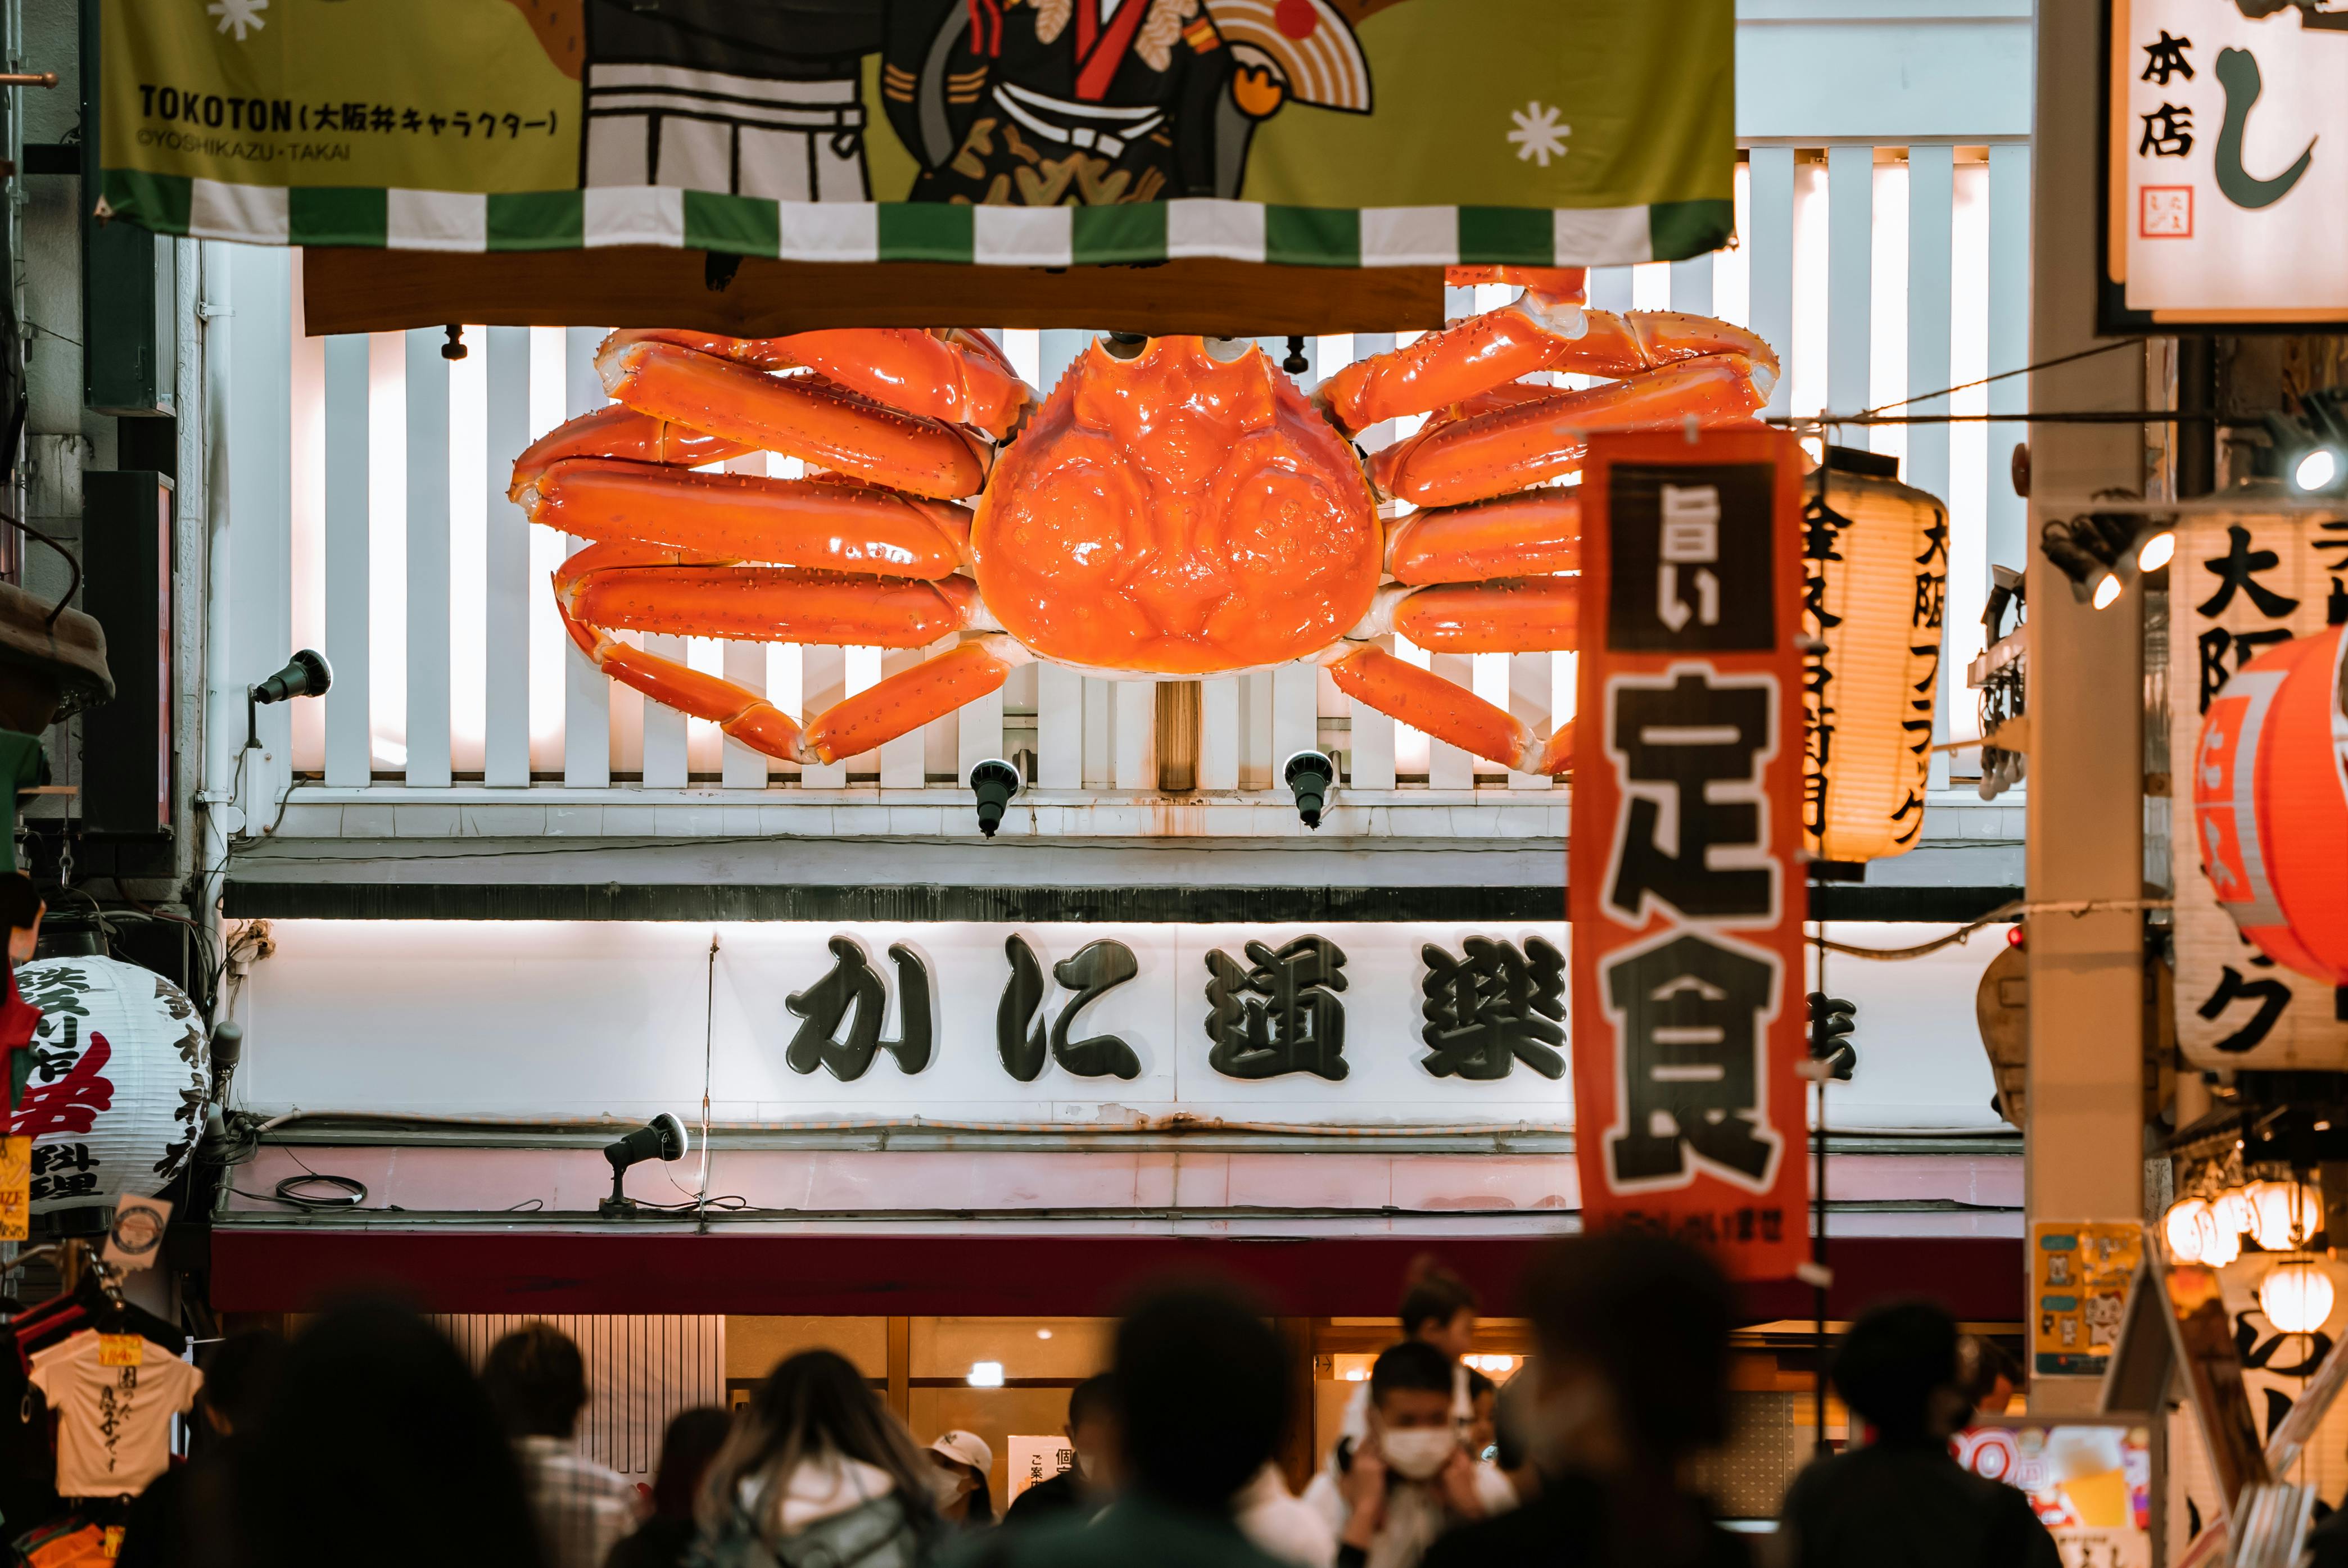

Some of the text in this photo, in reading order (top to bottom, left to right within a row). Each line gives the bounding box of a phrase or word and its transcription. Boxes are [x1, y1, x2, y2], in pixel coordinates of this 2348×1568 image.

[139, 84, 292, 133] TOKOTON
[2141, 29, 2193, 157] 本店
[1657, 483, 1721, 632] 旨い
[1597, 660, 1785, 1196] 定食
